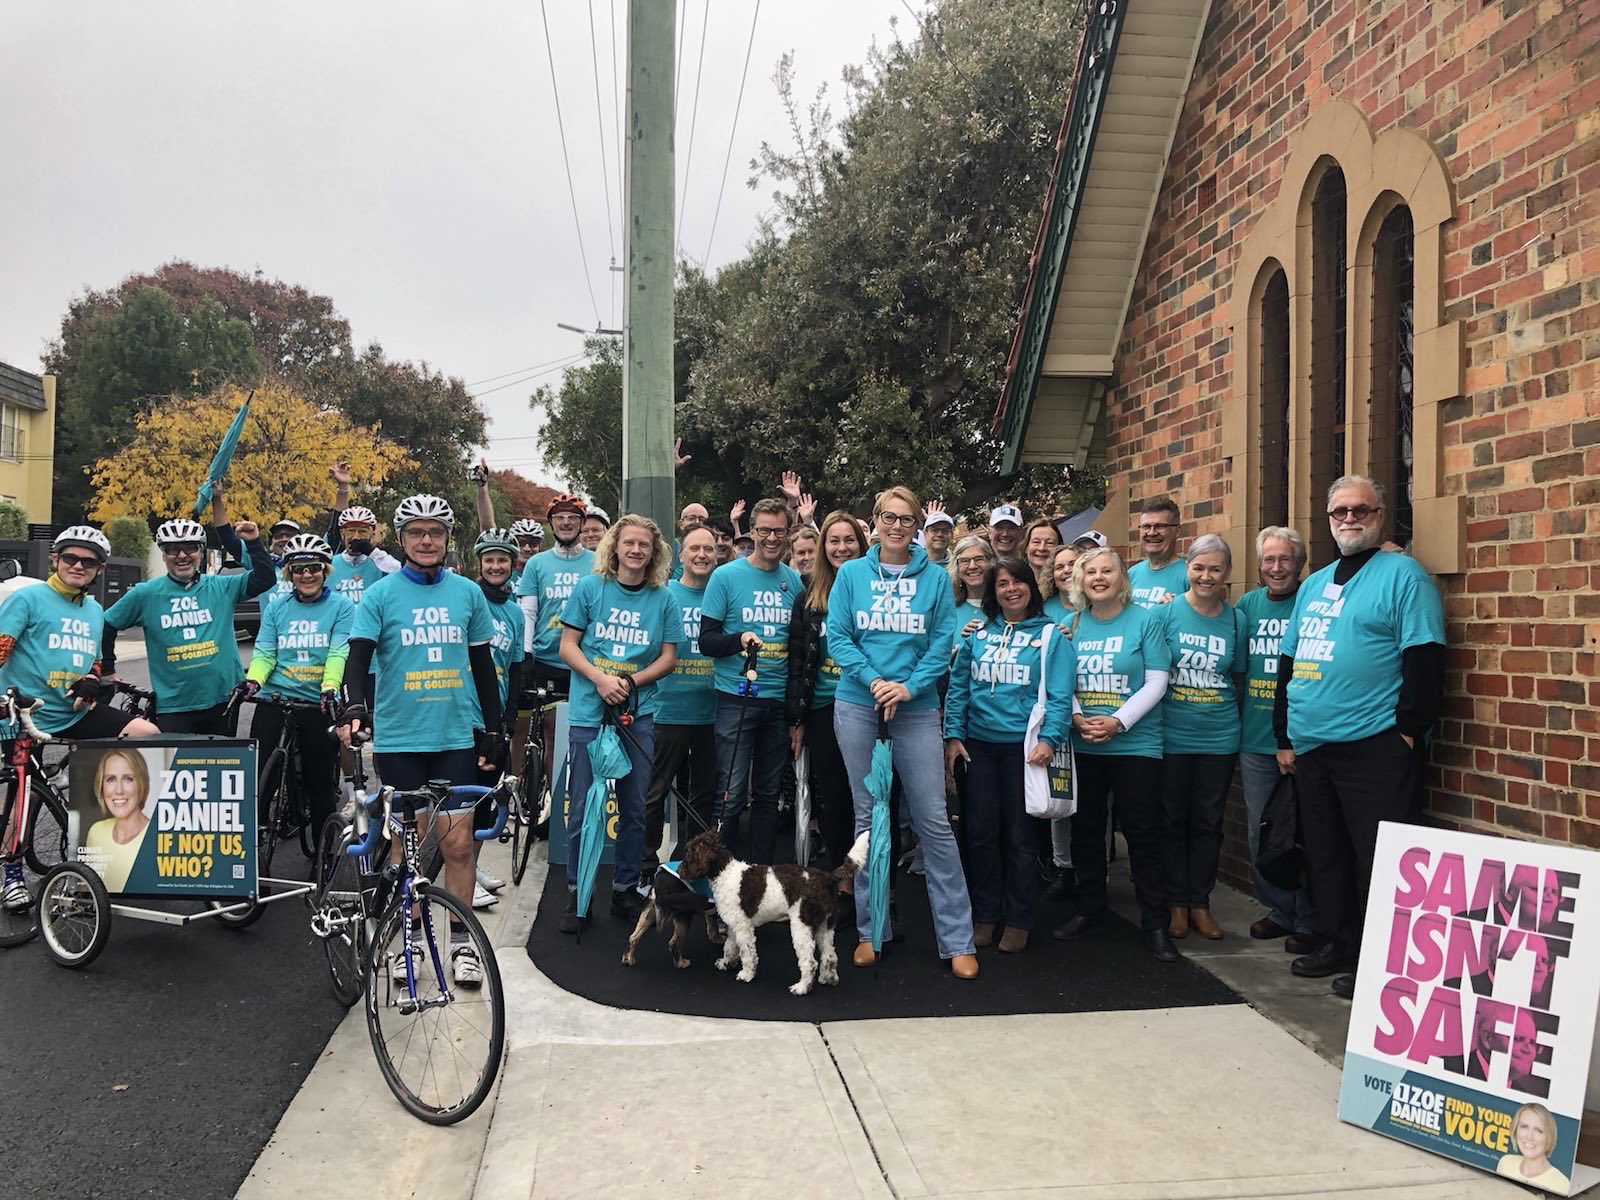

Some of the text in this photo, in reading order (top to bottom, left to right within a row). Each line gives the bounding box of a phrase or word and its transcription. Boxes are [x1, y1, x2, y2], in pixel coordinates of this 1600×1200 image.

[340, 579, 364, 590] ZOE
[546, 585, 571, 599] DAN
[170, 596, 199, 613] ZOE
[753, 590, 783, 607] ZOE
[870, 595, 912, 613] ZOE
[160, 609, 213, 629] DANIEL
[412, 606, 450, 625] ZOE
[607, 607, 641, 627] ZOE
[682, 606, 701, 622] ZO
[856, 610, 926, 634] DANIEL
[61, 617, 91, 637] ZOE
[288, 619, 319, 634] ZOE
[400, 625, 463, 646] DANIEL
[492, 618, 507, 633] OE
[595, 621, 650, 646] DANIEL
[1299, 616, 1332, 640] ZOE
[278, 633, 330, 649] DANIEL
[1078, 640, 1104, 651] VOTE
[1179, 632, 1207, 648] VOTE
[980, 644, 1021, 663] ZOE
[1077, 653, 1115, 674] ZOE
[1177, 648, 1219, 672] ZOE
[971, 660, 1031, 686] DANIEL
[404, 681, 421, 691] FOR
[1077, 674, 1131, 694] ANIEL
[158, 770, 208, 800] ZOE
[157, 802, 245, 832] DANIEL
[157, 833, 246, 859] IF NOT US,
[157, 856, 213, 878] WHO?
[1395, 846, 1581, 940] SAME
[405, 908, 413, 951] TREK
[1385, 906, 1571, 1011] ISN'T
[1373, 976, 1561, 1100] SAFE
[1364, 1074, 1393, 1095] VOTE
[1409, 1085, 1446, 1114] ZOE
[1391, 1099, 1441, 1131] DANIEL
[1445, 1096, 1513, 1128] FIND YOUR
[1444, 1110, 1511, 1153] VOICE
